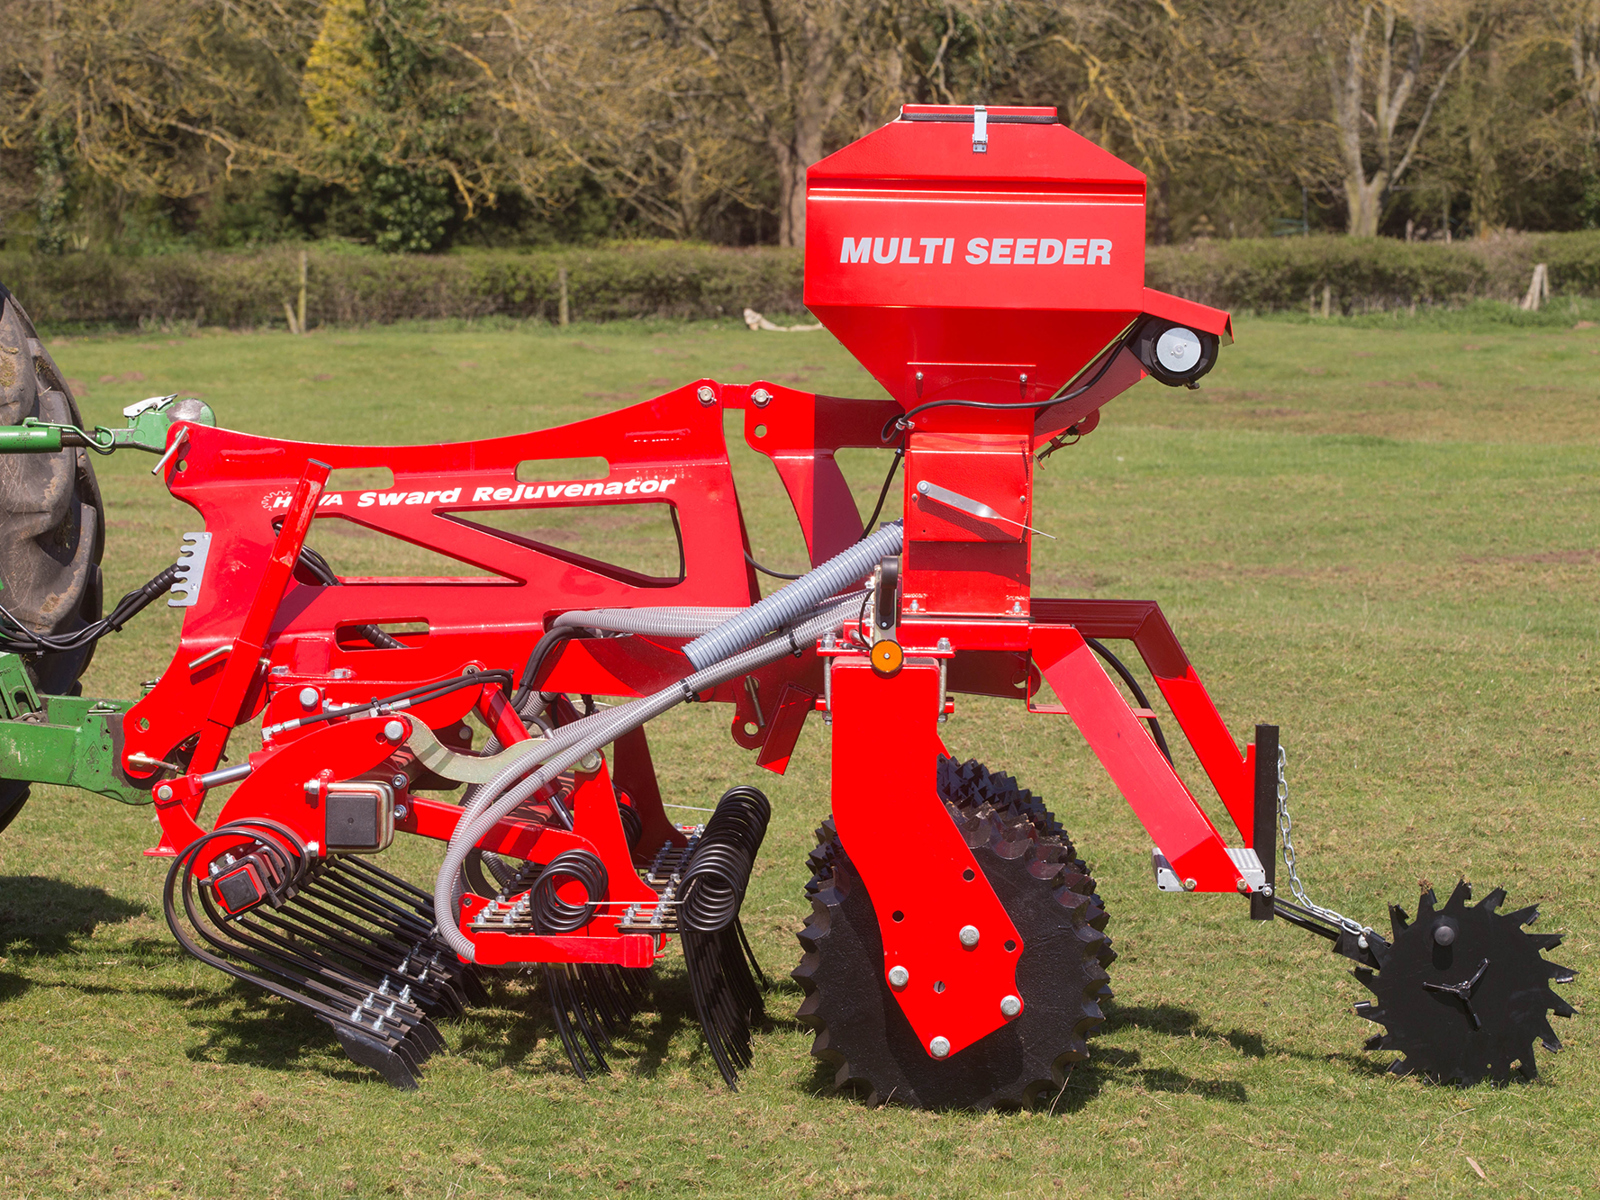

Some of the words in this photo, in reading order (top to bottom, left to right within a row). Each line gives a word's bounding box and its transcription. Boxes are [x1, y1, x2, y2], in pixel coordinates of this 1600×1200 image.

[840, 237, 955, 264] MULTI
[965, 237, 1113, 265] SEEDER
[357, 487, 462, 507] Sward
[472, 478, 676, 502] Rejuvenator
